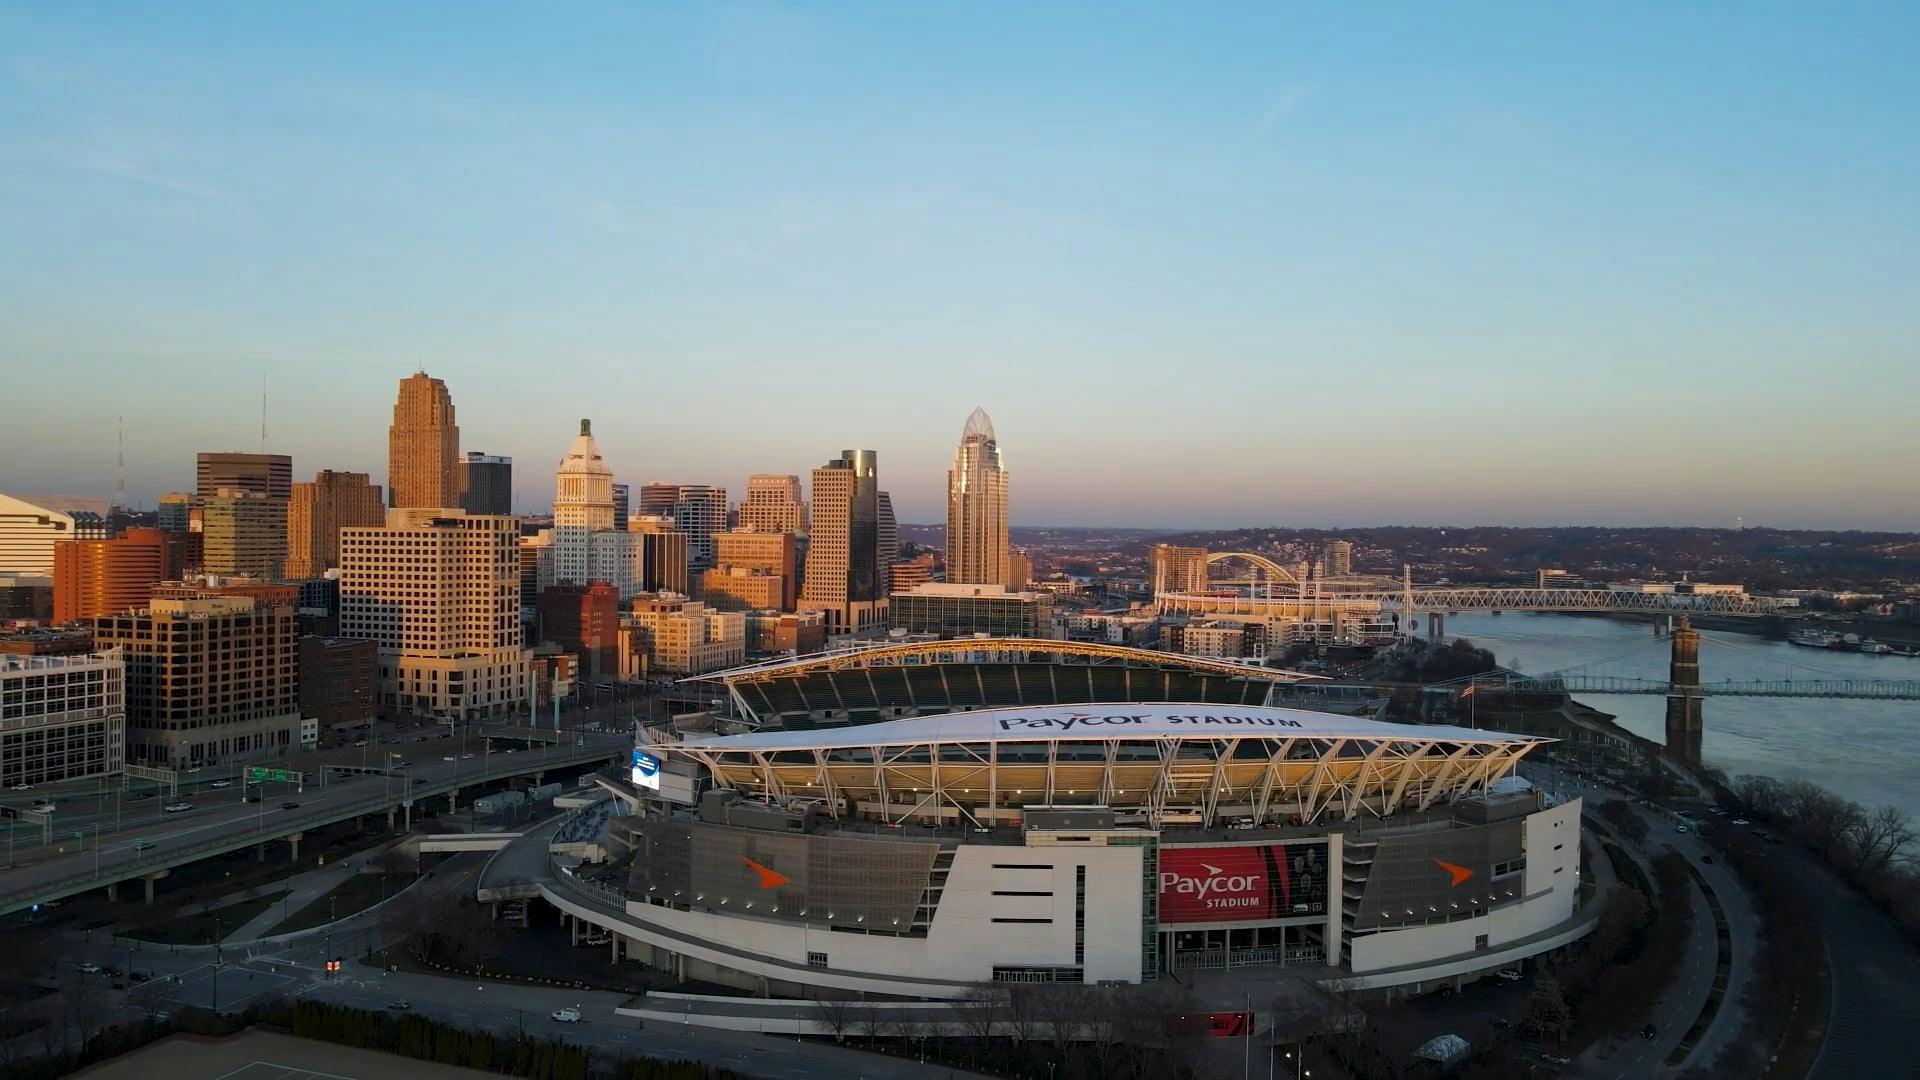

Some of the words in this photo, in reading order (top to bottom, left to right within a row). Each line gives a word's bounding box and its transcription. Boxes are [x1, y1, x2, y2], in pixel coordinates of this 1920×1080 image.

[1000, 715, 1150, 730] Paycor
[1166, 715, 1302, 728] STADIUM
[1160, 872, 1260, 899] Paycor
[1206, 897, 1260, 908] STADIUM
